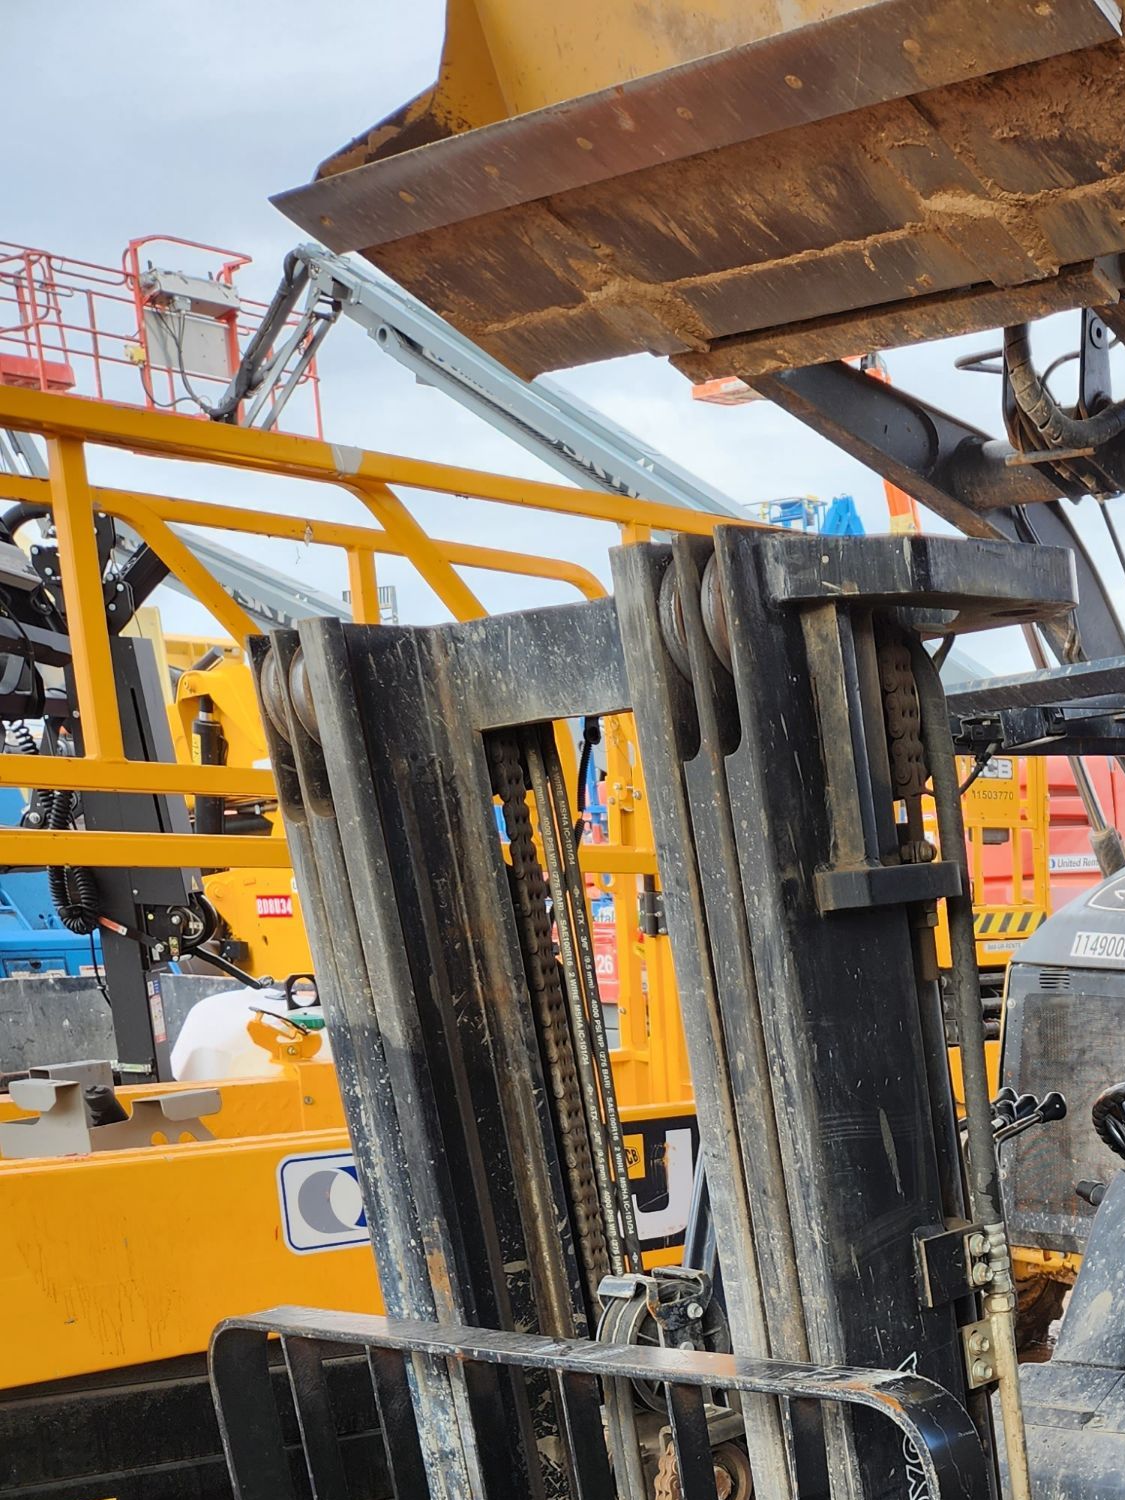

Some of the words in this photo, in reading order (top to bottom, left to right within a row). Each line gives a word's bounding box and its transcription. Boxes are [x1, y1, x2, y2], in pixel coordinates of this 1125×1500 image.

[554, 774, 564, 797] WIRE
[560, 800, 568, 826] MSHA
[1057, 858, 1081, 868] United
[570, 978, 581, 1001] WIRE
[590, 999, 600, 1018] 4000
[615, 1152, 625, 1173] WIRE
[618, 1176, 628, 1200] MSHA
